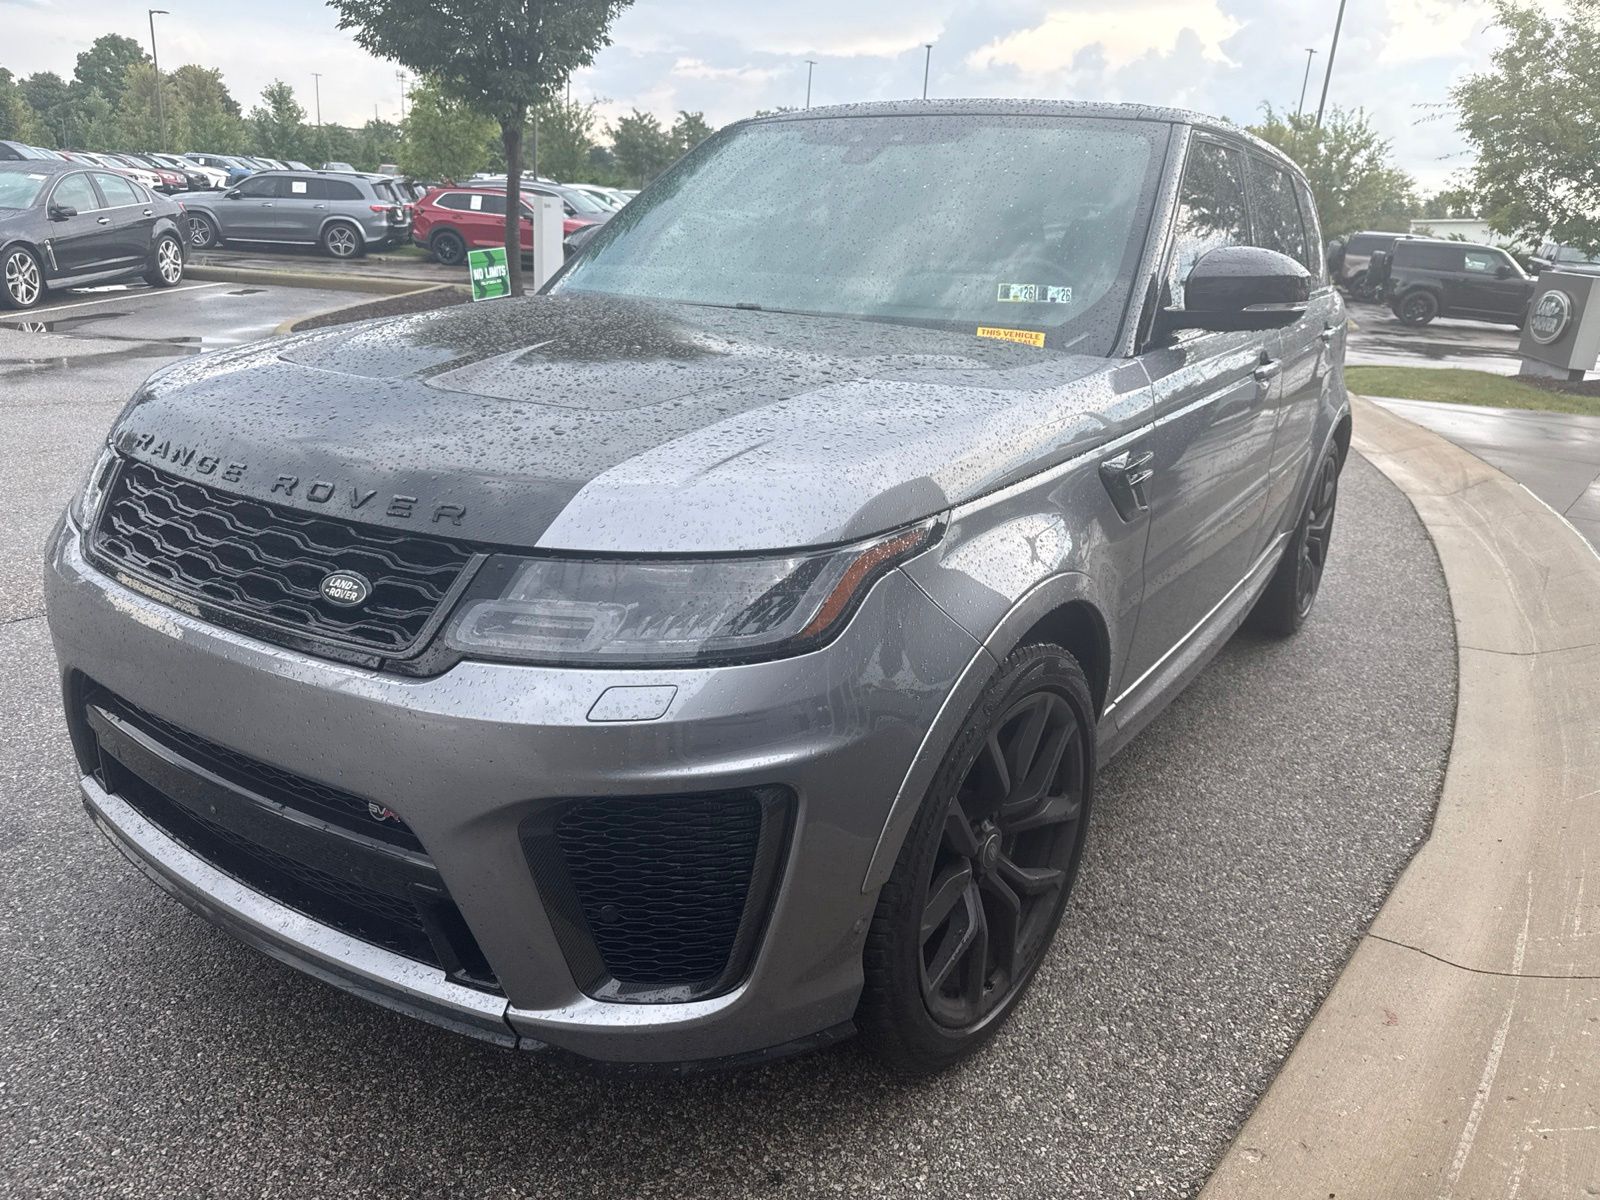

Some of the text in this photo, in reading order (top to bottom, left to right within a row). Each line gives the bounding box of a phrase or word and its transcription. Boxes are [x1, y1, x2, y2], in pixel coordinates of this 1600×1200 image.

[473, 265, 506, 280] NO LIMITS
[1024, 286, 1033, 300] 26
[1061, 288, 1070, 302] 26
[1003, 330, 1041, 340] VEHICLE
[136, 433, 467, 527] RANGE ROVER
